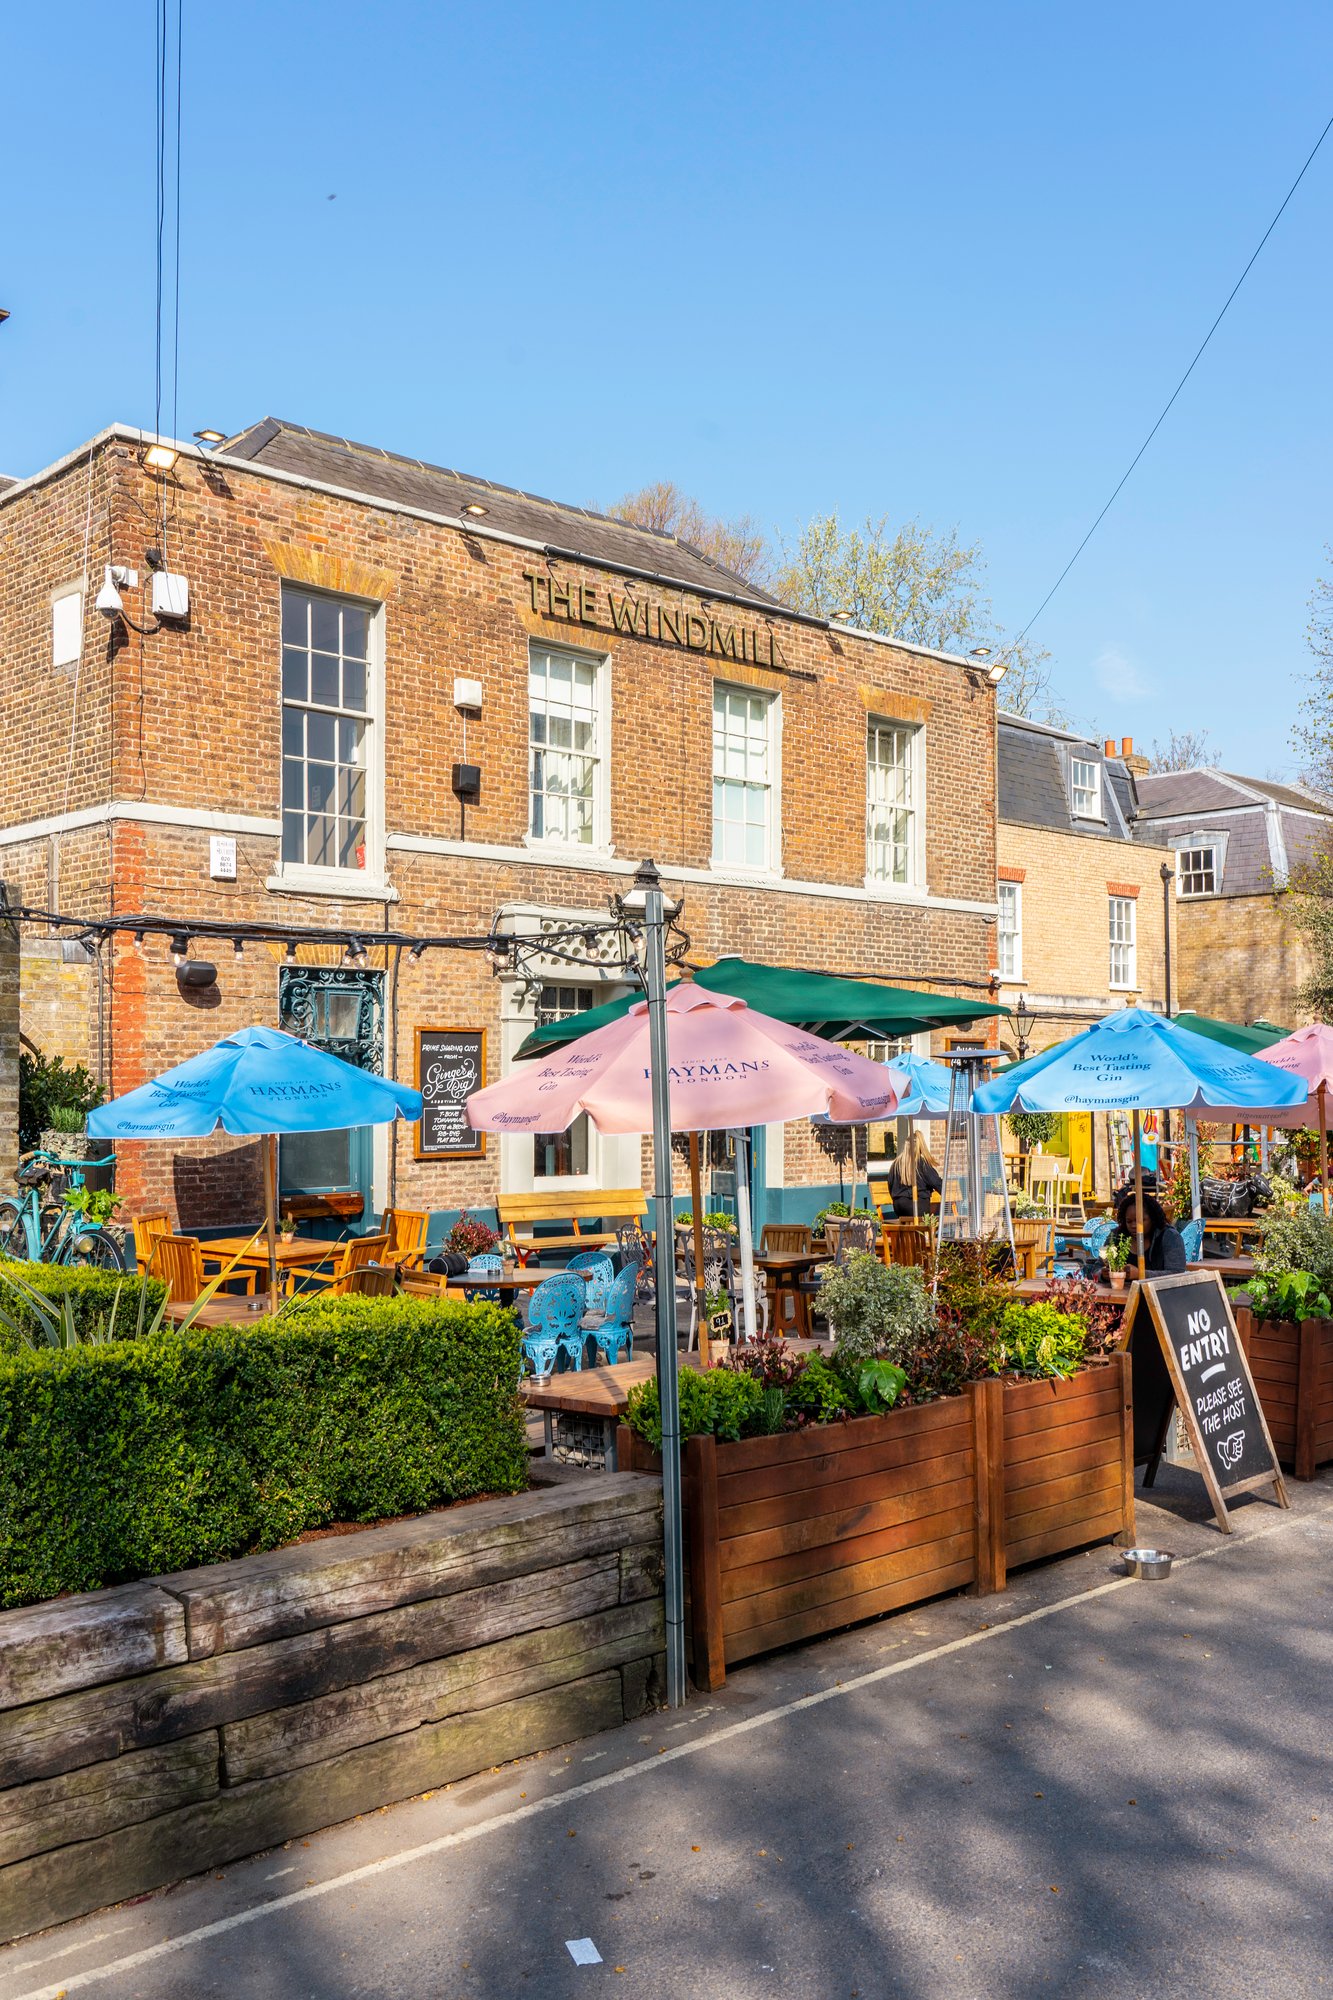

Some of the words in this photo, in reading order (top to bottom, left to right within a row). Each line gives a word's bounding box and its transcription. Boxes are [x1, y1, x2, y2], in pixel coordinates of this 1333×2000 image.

[523, 570, 597, 624] THE
[608, 592, 788, 669] WINDMILL
[422, 1044, 440, 1052] PRIME
[440, 1044, 463, 1053] SHARING
[1090, 1053, 1139, 1062] World's
[427, 1060, 474, 1083] Ginger
[538, 1067, 561, 1077] Best
[560, 1067, 594, 1078] Tasting
[1072, 1063, 1100, 1072] Best
[1103, 1063, 1152, 1071] Tasting
[676, 1073, 747, 1084] LONDON
[1096, 1073, 1122, 1082] Gin
[174, 1079, 210, 1088] World's
[249, 1081, 342, 1096] HAYMANS
[538, 1080, 558, 1091] Gin
[148, 1090, 173, 1098] Best
[1064, 1094, 1140, 1106] @haymansgin
[116, 1120, 175, 1133] @haymansgin
[715, 1316, 726, 1326] 91
[1187, 1308, 1211, 1336] NO
[1180, 1326, 1231, 1371] ENTRY
[1196, 1385, 1228, 1416] PLEASE
[1227, 1377, 1244, 1398] SEE
[1202, 1413, 1221, 1436] THE
[1223, 1397, 1247, 1426] HOST
